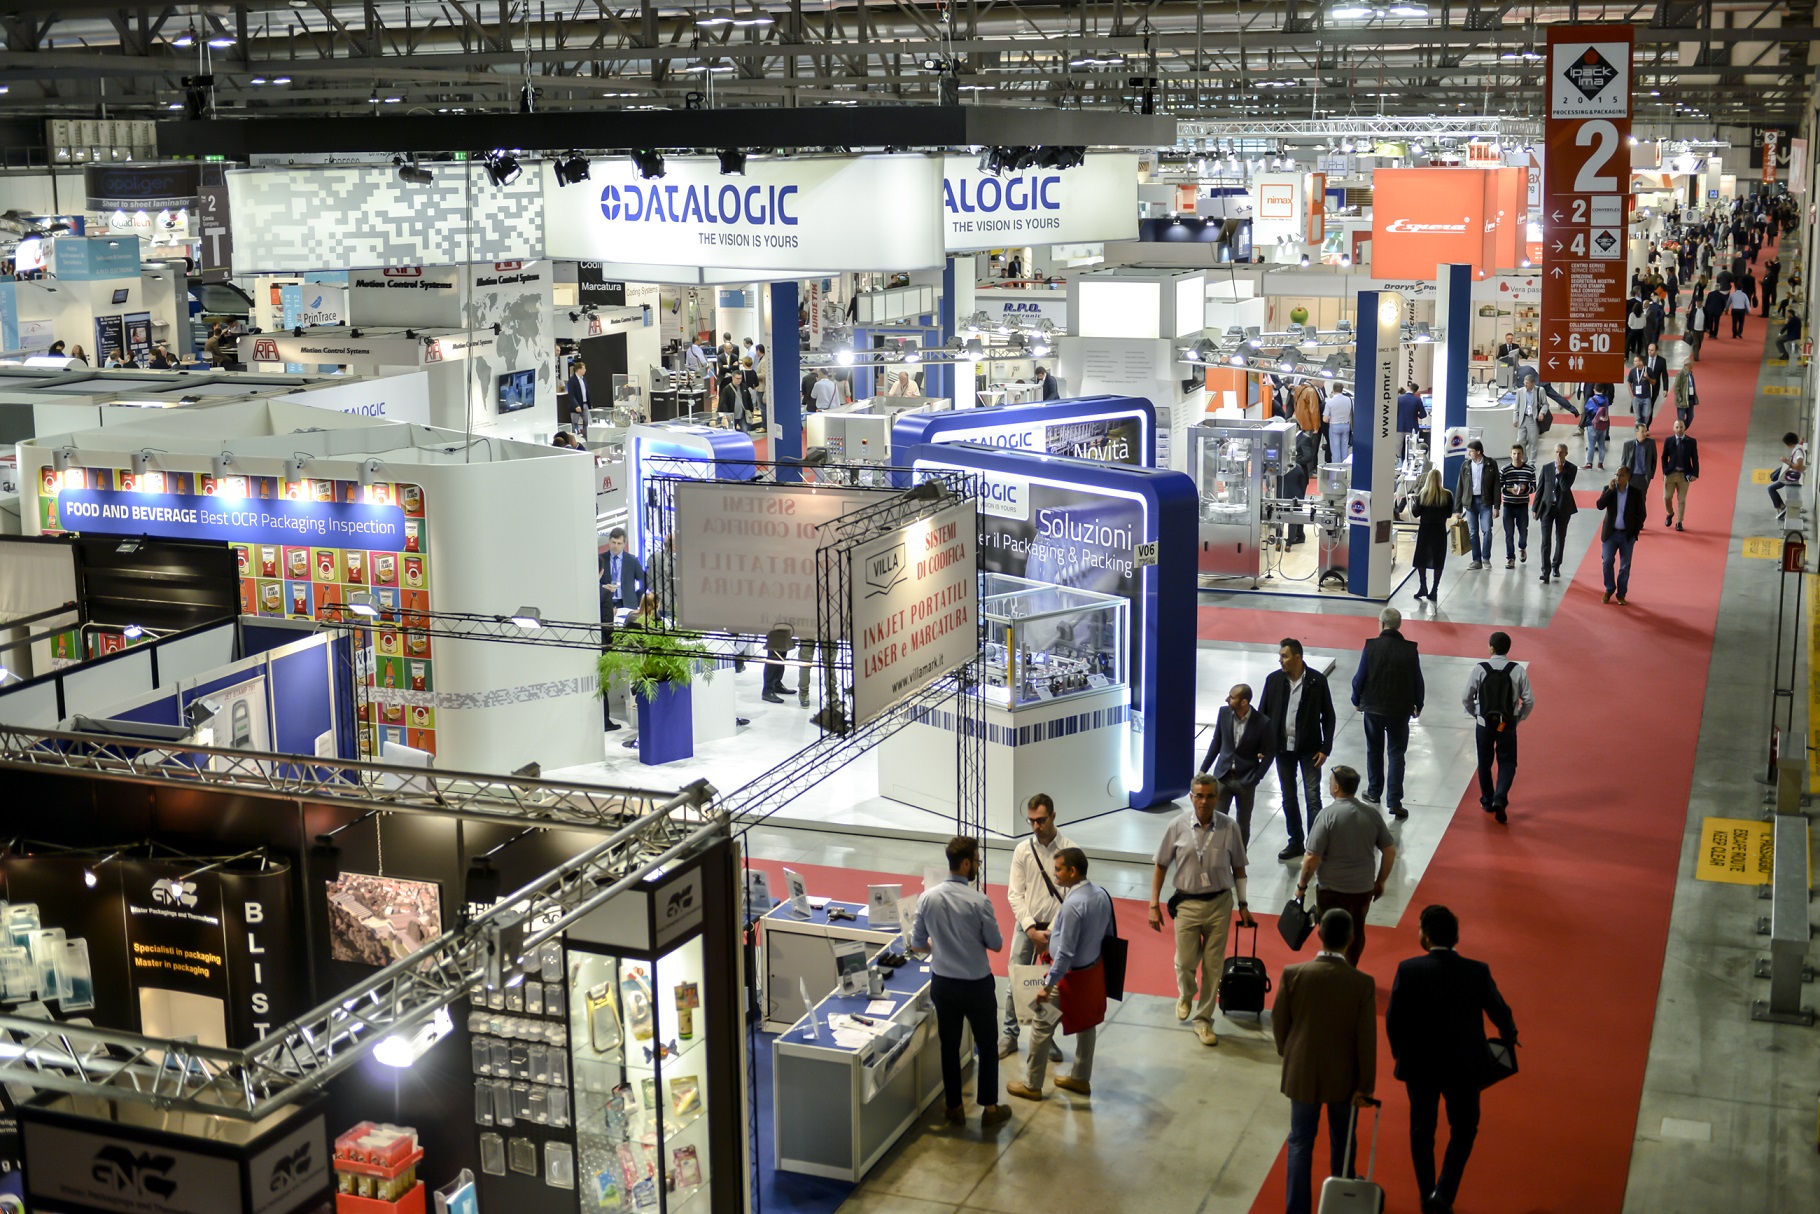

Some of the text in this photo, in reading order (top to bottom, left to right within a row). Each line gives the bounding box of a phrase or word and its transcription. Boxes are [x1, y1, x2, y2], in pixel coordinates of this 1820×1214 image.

[1570, 66, 1612, 78] ipack
[1578, 77, 1604, 86] ima
[1574, 119, 1619, 192] 2
[1768, 144, 1776, 155] 2
[102, 200, 120, 208] Sheet
[152, 200, 190, 208] laminator
[208, 194, 217, 212] 2
[624, 184, 798, 226] DATALOGIC
[1267, 196, 1292, 204] nimax
[1572, 200, 1586, 223] 2
[111, 217, 151, 230] QuadTech
[952, 218, 1060, 232] THE VISION IS YOURS
[1386, 218, 1466, 232] Espera
[204, 227, 226, 266] T
[698, 232, 798, 248] THE VISION IS YOURS
[1570, 234, 1586, 256] 4
[356, 280, 452, 290] Motion Control Systems
[476, 274, 540, 286] Motion Control Systems
[582, 282, 622, 291] Marcatura
[626, 286, 658, 298] Coding Systems
[1003, 302, 1042, 312] R.P.O.
[304, 312, 336, 324] PrinTrace
[254, 340, 280, 360] RTA
[1569, 333, 1610, 352] 6-10
[1382, 361, 1392, 438] www.pmr.it
[1074, 437, 1130, 460] Novità
[66, 501, 396, 536] FOOD AND BEVERAGE Best OCR Packaging Inspection
[926, 521, 956, 551] SISTEMI
[1040, 510, 1132, 550] Soluzioni
[992, 532, 1000, 549] il
[1004, 534, 1065, 566] Packaging
[1068, 547, 1078, 562] &
[1082, 550, 1132, 578] Packing
[1138, 544, 1154, 557] V06
[874, 553, 898, 578] VILLA
[917, 542, 966, 580] DI CODIFICA
[864, 610, 905, 650] INKJET
[911, 578, 967, 624] PORTATILI
[864, 643, 897, 678] LASER
[901, 642, 907, 658] e
[910, 606, 968, 652] MARCATURA
[892, 653, 944, 694] www.villamark.it
[233, 686, 248, 698] STAMP
[1710, 830, 1728, 866] KEEP CLEAR
[1730, 828, 1748, 872] ESCAPE ROUTE
[149, 908, 177, 918] Packagings
[133, 942, 222, 966] Specialisti in packaging
[134, 957, 210, 978] Master in packaging
